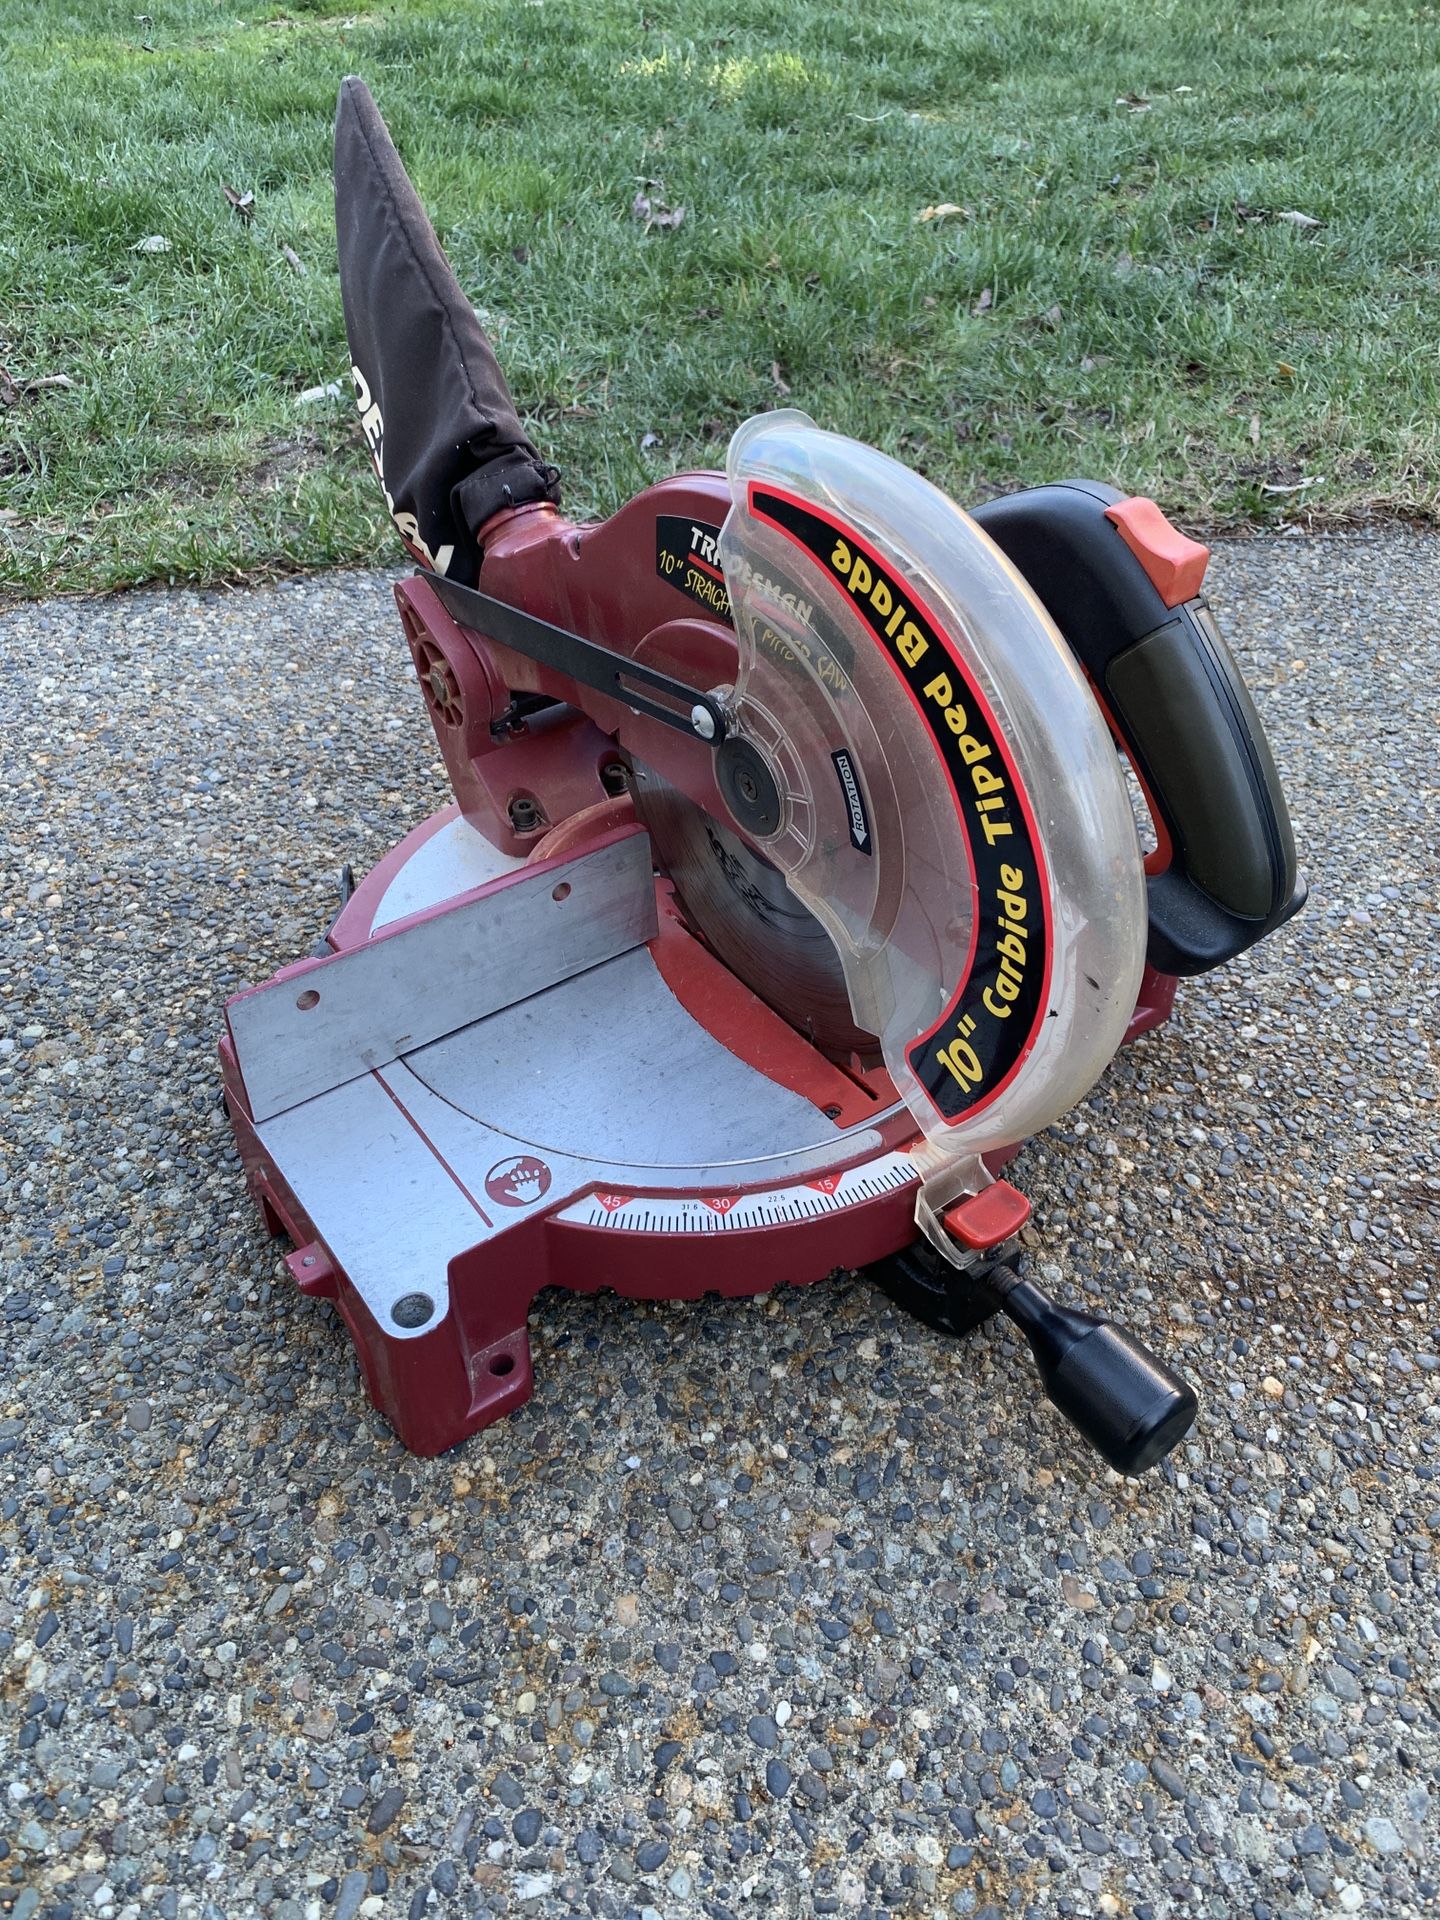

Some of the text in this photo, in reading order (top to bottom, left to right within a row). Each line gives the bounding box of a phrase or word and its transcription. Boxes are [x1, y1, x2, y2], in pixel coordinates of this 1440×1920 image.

[659, 550, 684, 575] 10"
[684, 568, 733, 617] STRAIGH
[831, 539, 1029, 1094] 10" Carbide Tipped Blade
[838, 758, 864, 832] ROTATION
[602, 1194, 622, 1208] 45
[712, 1198, 731, 1210] 30
[816, 1178, 835, 1192] 15
